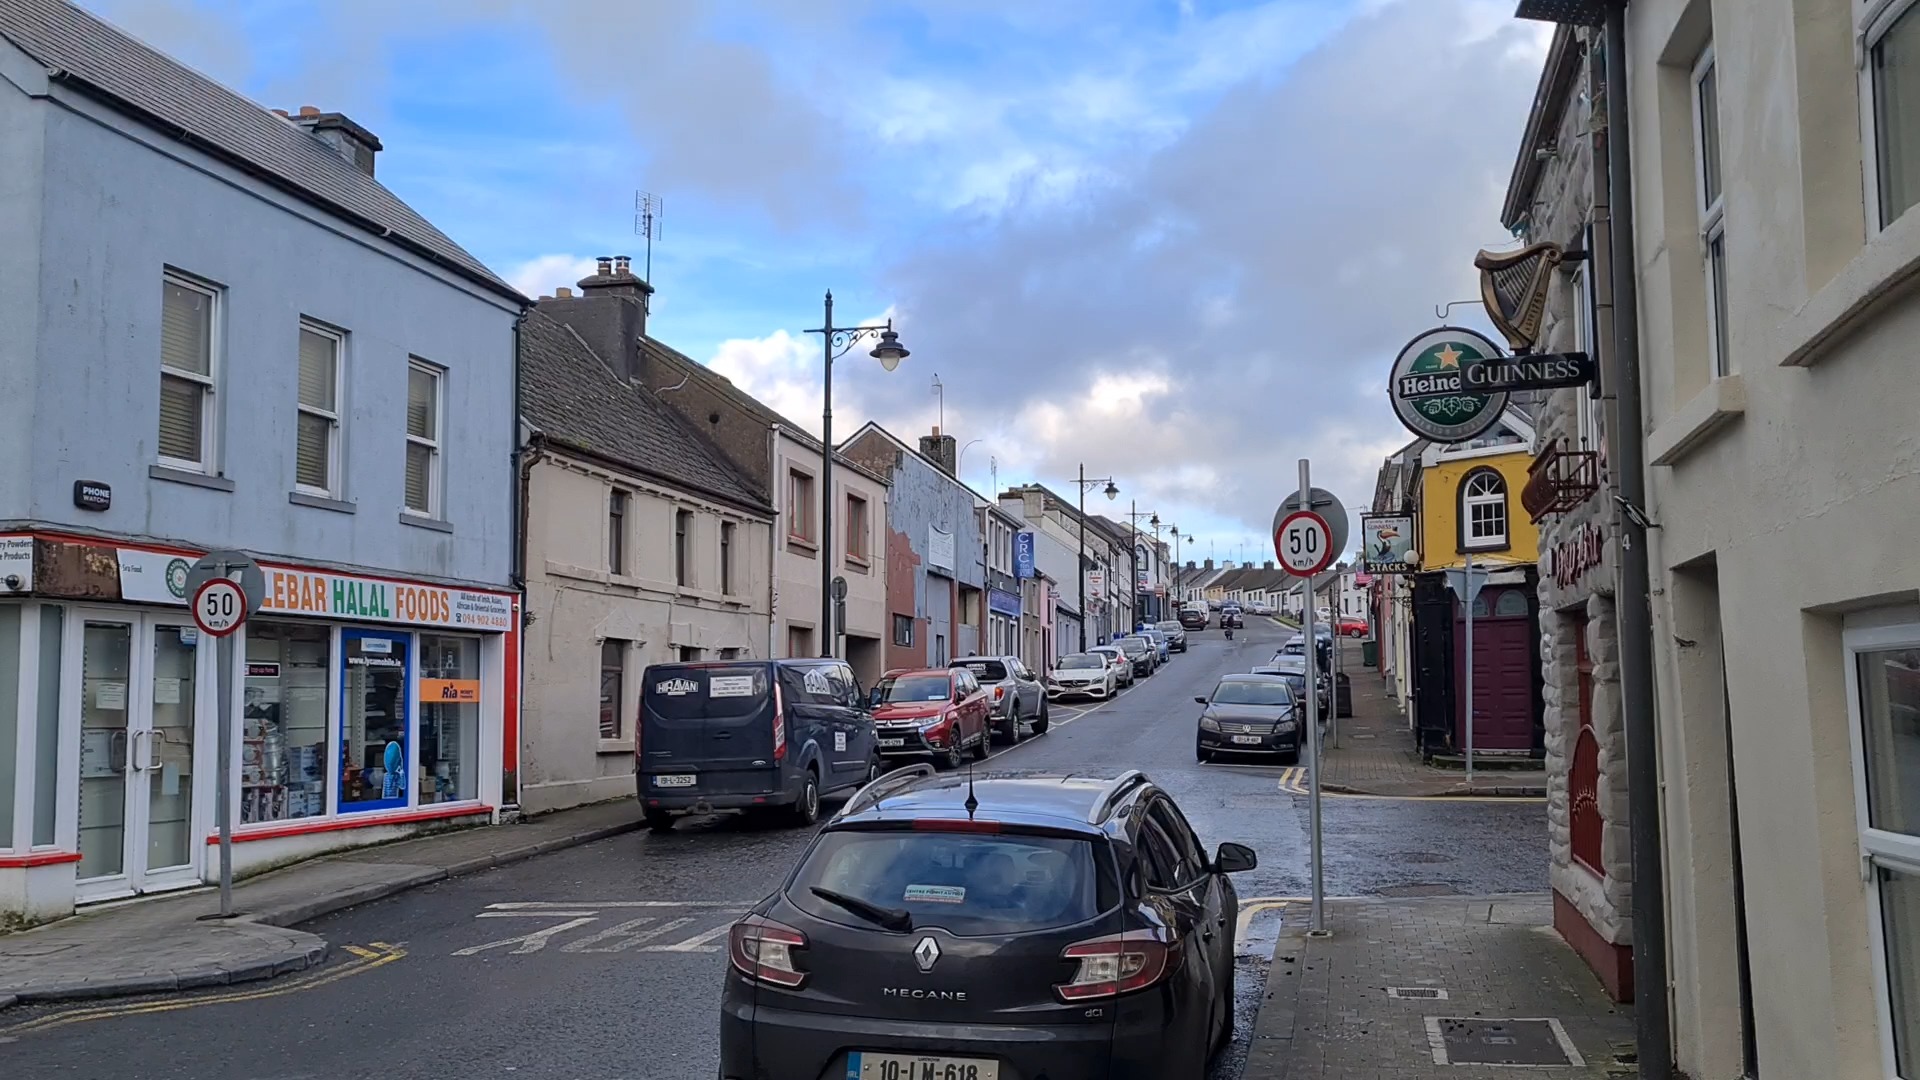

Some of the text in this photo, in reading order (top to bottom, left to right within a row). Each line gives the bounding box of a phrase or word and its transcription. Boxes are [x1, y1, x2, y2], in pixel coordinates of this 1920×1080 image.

[1467, 360, 1580, 384] GUINNESS
[1403, 375, 1461, 395] Heine
[83, 486, 110, 498] PHONE
[1290, 527, 1317, 554] 50
[1622, 534, 1631, 550] 4
[4, 552, 30, 560] Products
[1293, 557, 1314, 567] km/h
[1370, 563, 1407, 572] STACKS
[207, 593, 233, 616] 50
[333, 579, 389, 617] HALAL
[396, 587, 450, 622] FOODS
[208, 619, 229, 628] km/h
[462, 613, 475, 624] 094
[477, 615, 489, 625] 902
[442, 684, 458, 698] Ria
[656, 679, 698, 693] HIRAVAN
[883, 987, 967, 1001] MEGANE
